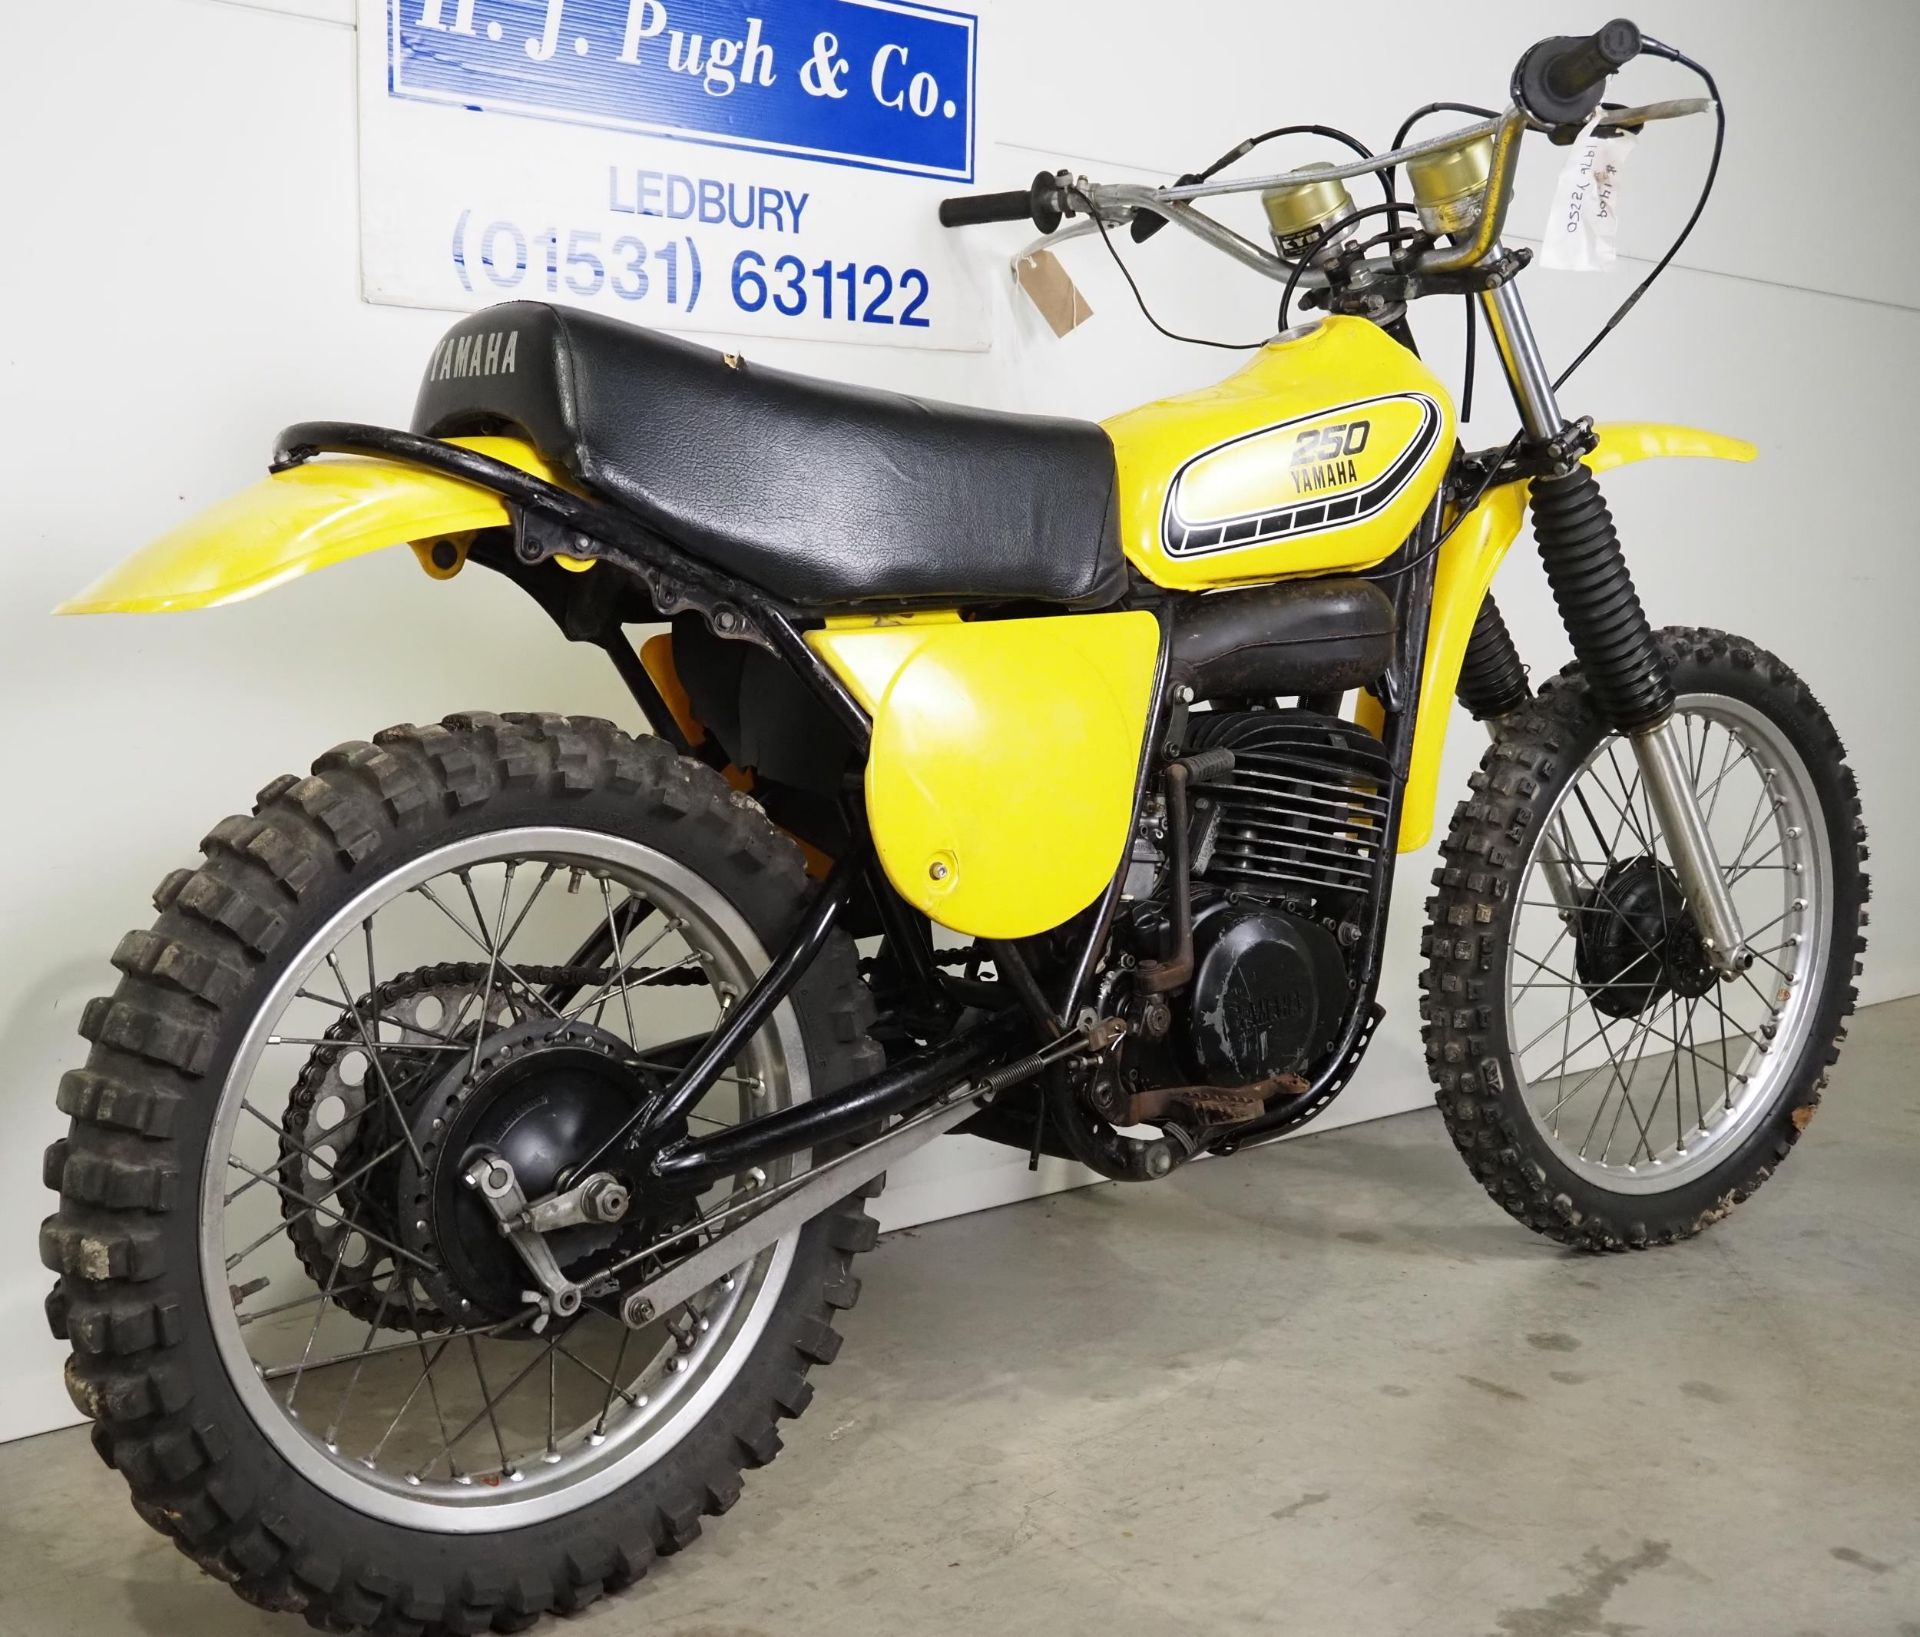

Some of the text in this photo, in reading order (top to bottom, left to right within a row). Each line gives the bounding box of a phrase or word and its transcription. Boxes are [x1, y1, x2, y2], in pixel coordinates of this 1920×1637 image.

[524, 0, 590, 61] J.
[616, 0, 777, 97] Pugh
[800, 31, 849, 99] &
[871, 43, 956, 119] Co.
[609, 165, 809, 234] LEDBURY
[452, 208, 930, 327] (01531) 631122
[430, 330, 518, 382] YAMAHA
[1291, 420, 1370, 466] 250
[1291, 459, 1358, 494] YAMAHA
